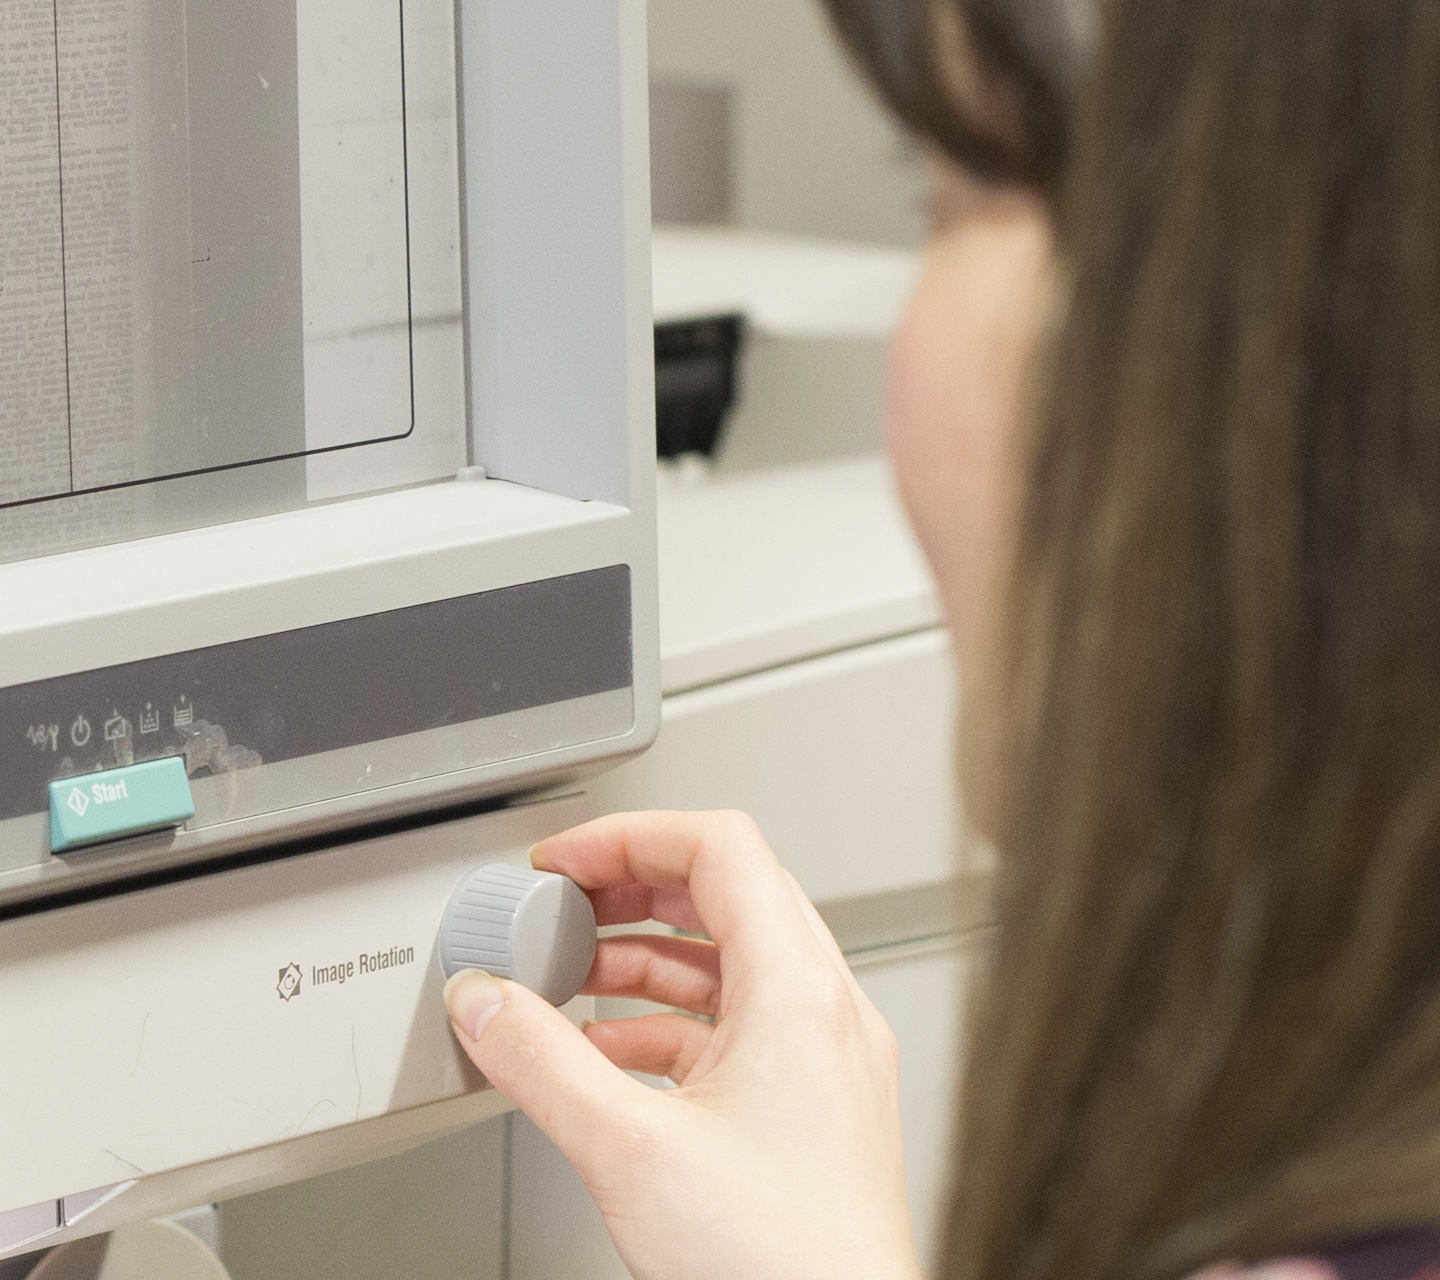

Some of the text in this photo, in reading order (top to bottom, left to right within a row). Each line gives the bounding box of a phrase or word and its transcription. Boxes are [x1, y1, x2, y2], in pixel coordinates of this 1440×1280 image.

[91, 778, 129, 805] Start
[312, 946, 415, 986] Image Rotation
